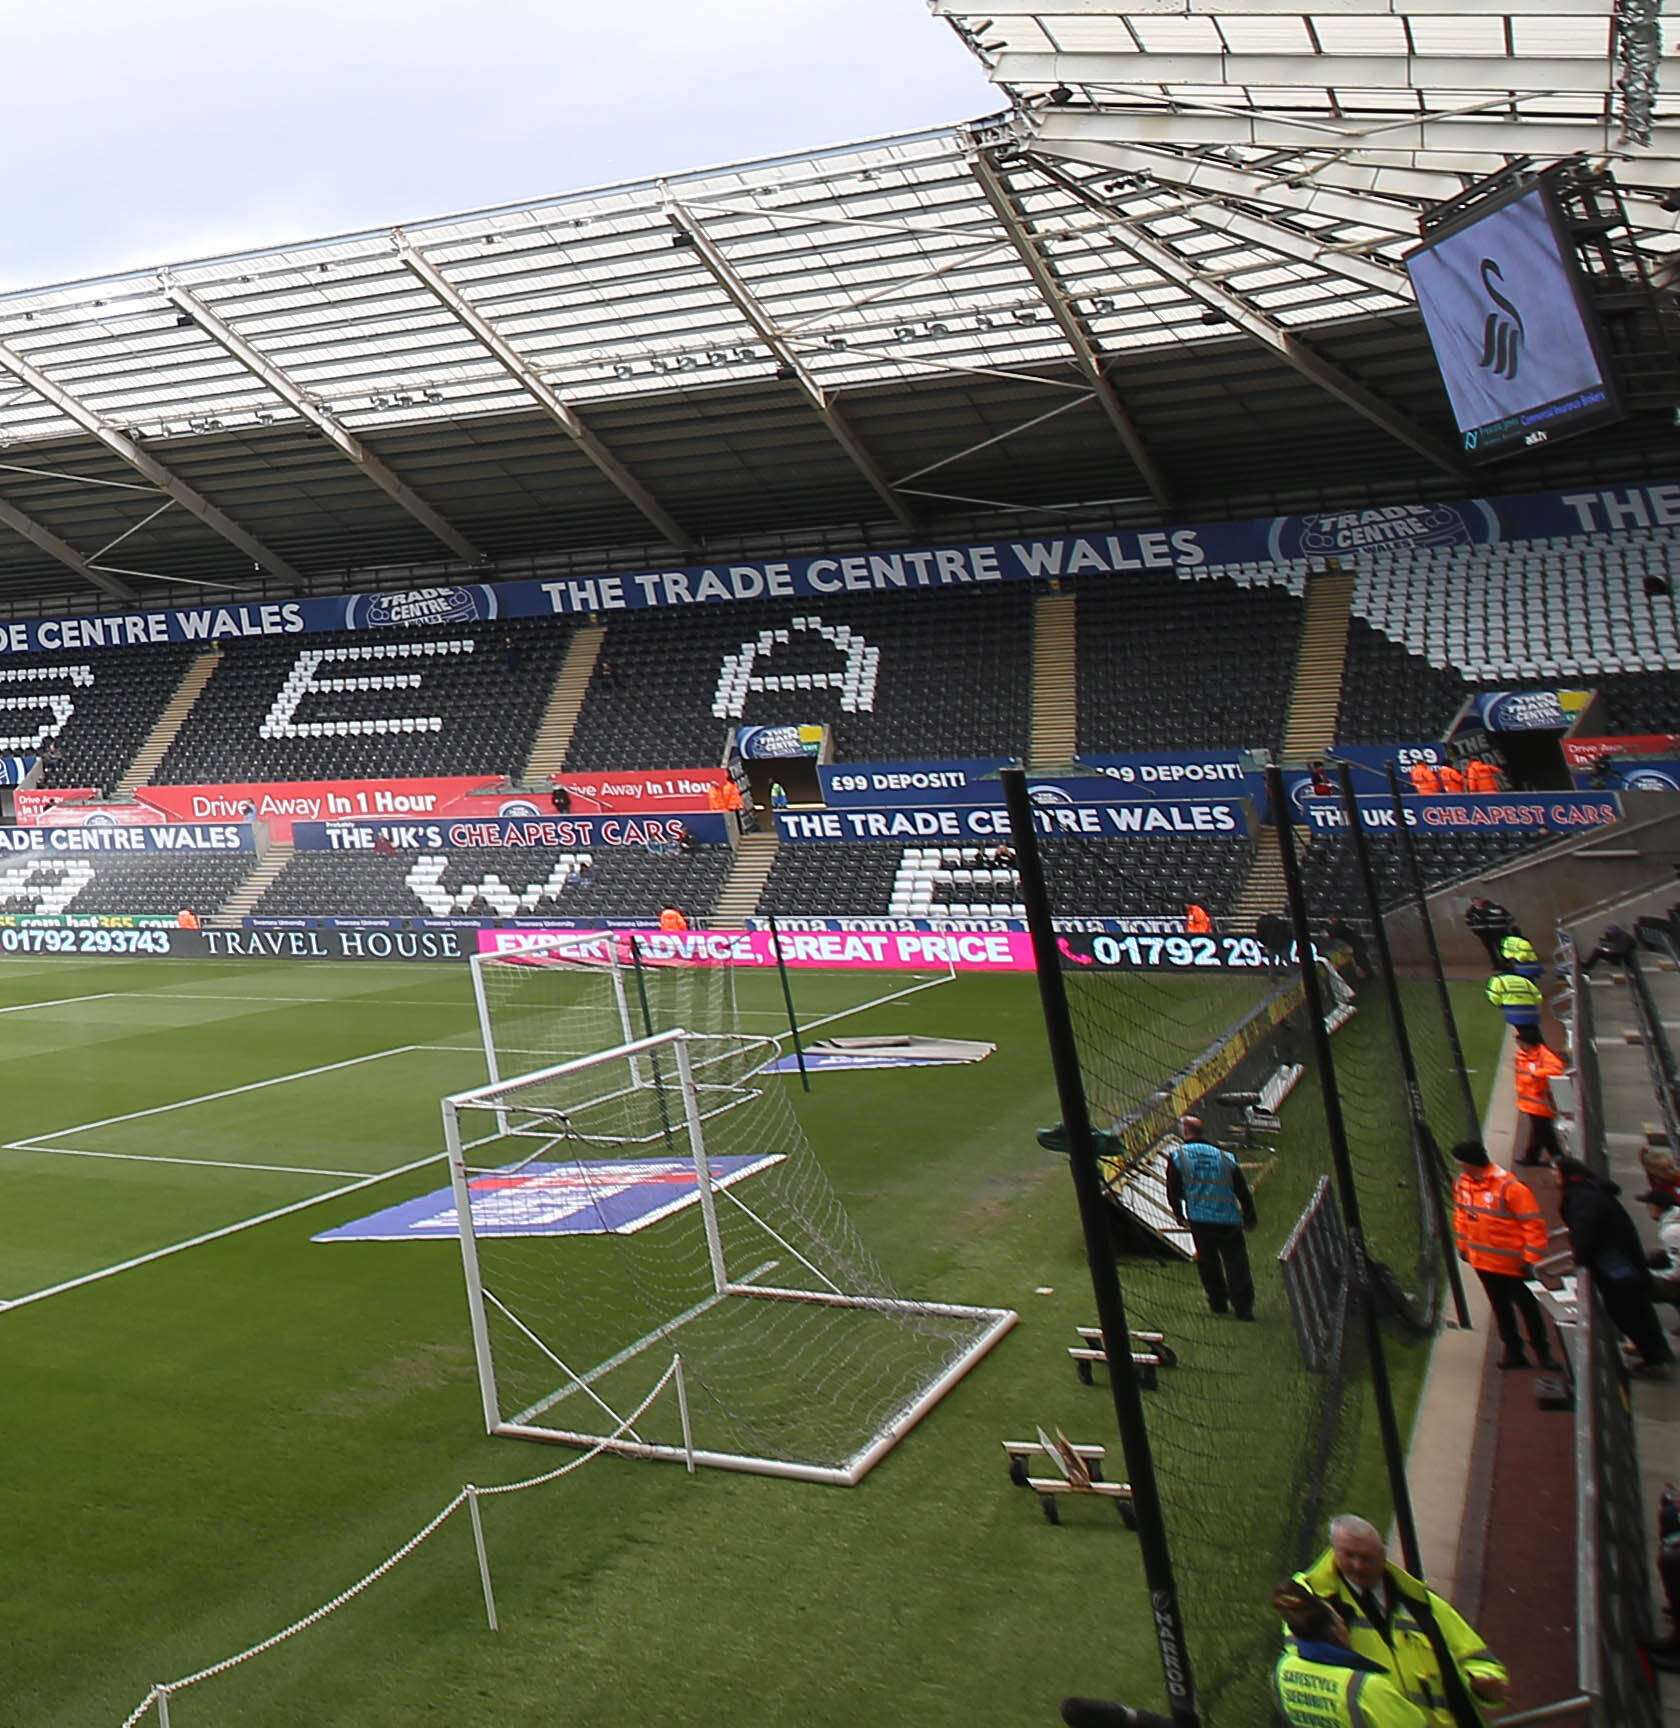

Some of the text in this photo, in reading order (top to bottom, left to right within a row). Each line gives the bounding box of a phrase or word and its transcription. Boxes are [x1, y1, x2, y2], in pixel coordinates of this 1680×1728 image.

[541, 530, 1204, 614] THE TRADE CENTRE WALES
[39, 613, 168, 651] CENTRE
[174, 604, 304, 641] WALES
[831, 772, 966, 791] £99 DEPOSIT!
[193, 793, 436, 820] Drive Away In 1 Hour
[326, 819, 683, 848] THE UK'S CHEAPEST CARS
[781, 805, 1235, 838] THE TRADE CETRE WALES
[1, 929, 170, 954] 01792 293743
[201, 931, 462, 957] TRAVEL HOUSE
[1092, 935, 1222, 967] 01792
